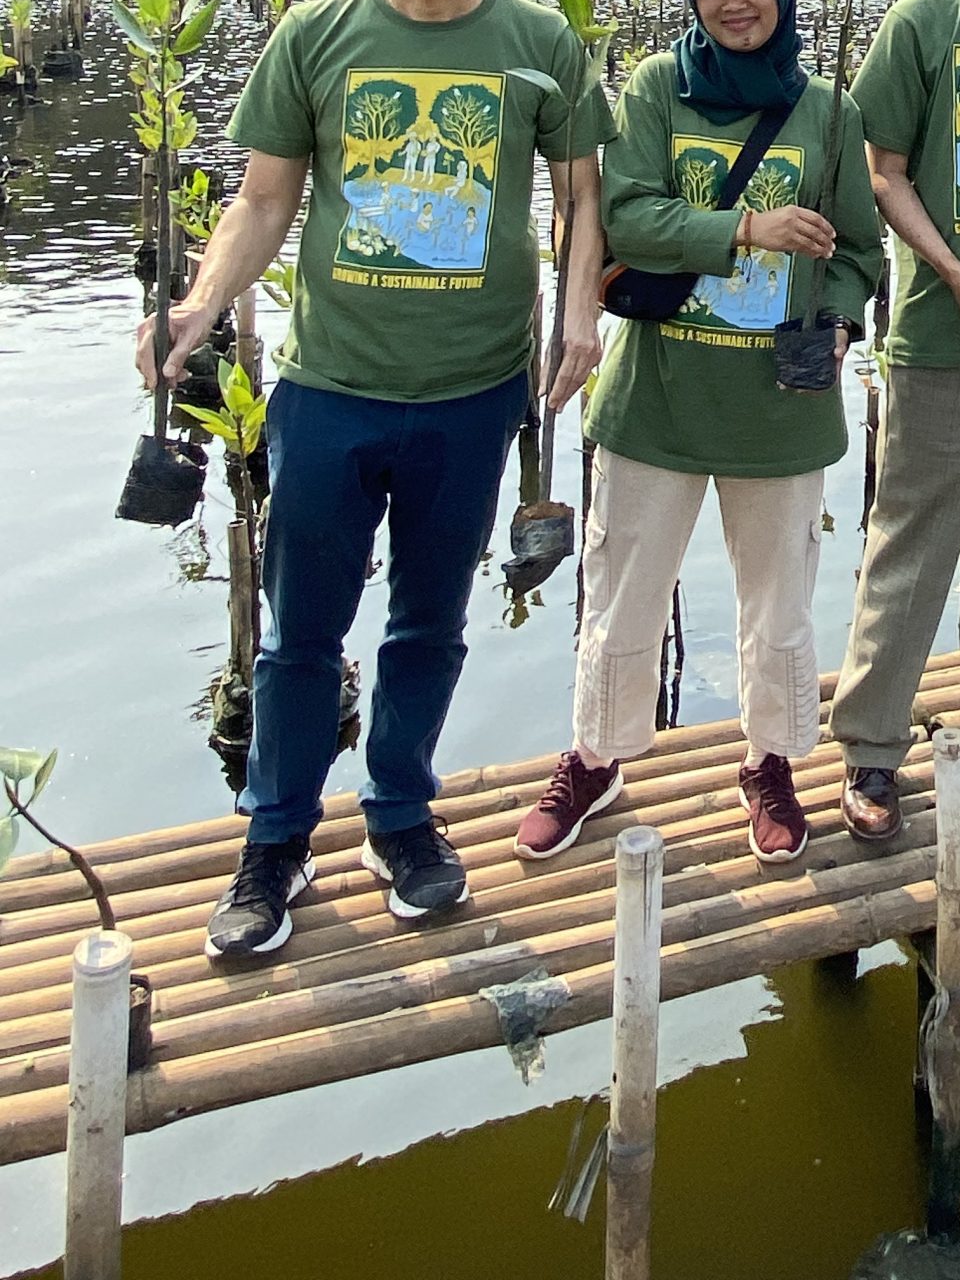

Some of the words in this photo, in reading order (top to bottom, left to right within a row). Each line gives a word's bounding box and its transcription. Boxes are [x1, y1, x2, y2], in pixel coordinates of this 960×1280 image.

[371, 274, 379, 286] A
[380, 275, 447, 289] SUSTAINABLE
[449, 276, 485, 289] FUTURE
[687, 330, 694, 340] A
[695, 331, 753, 348] SUSTAINABLE
